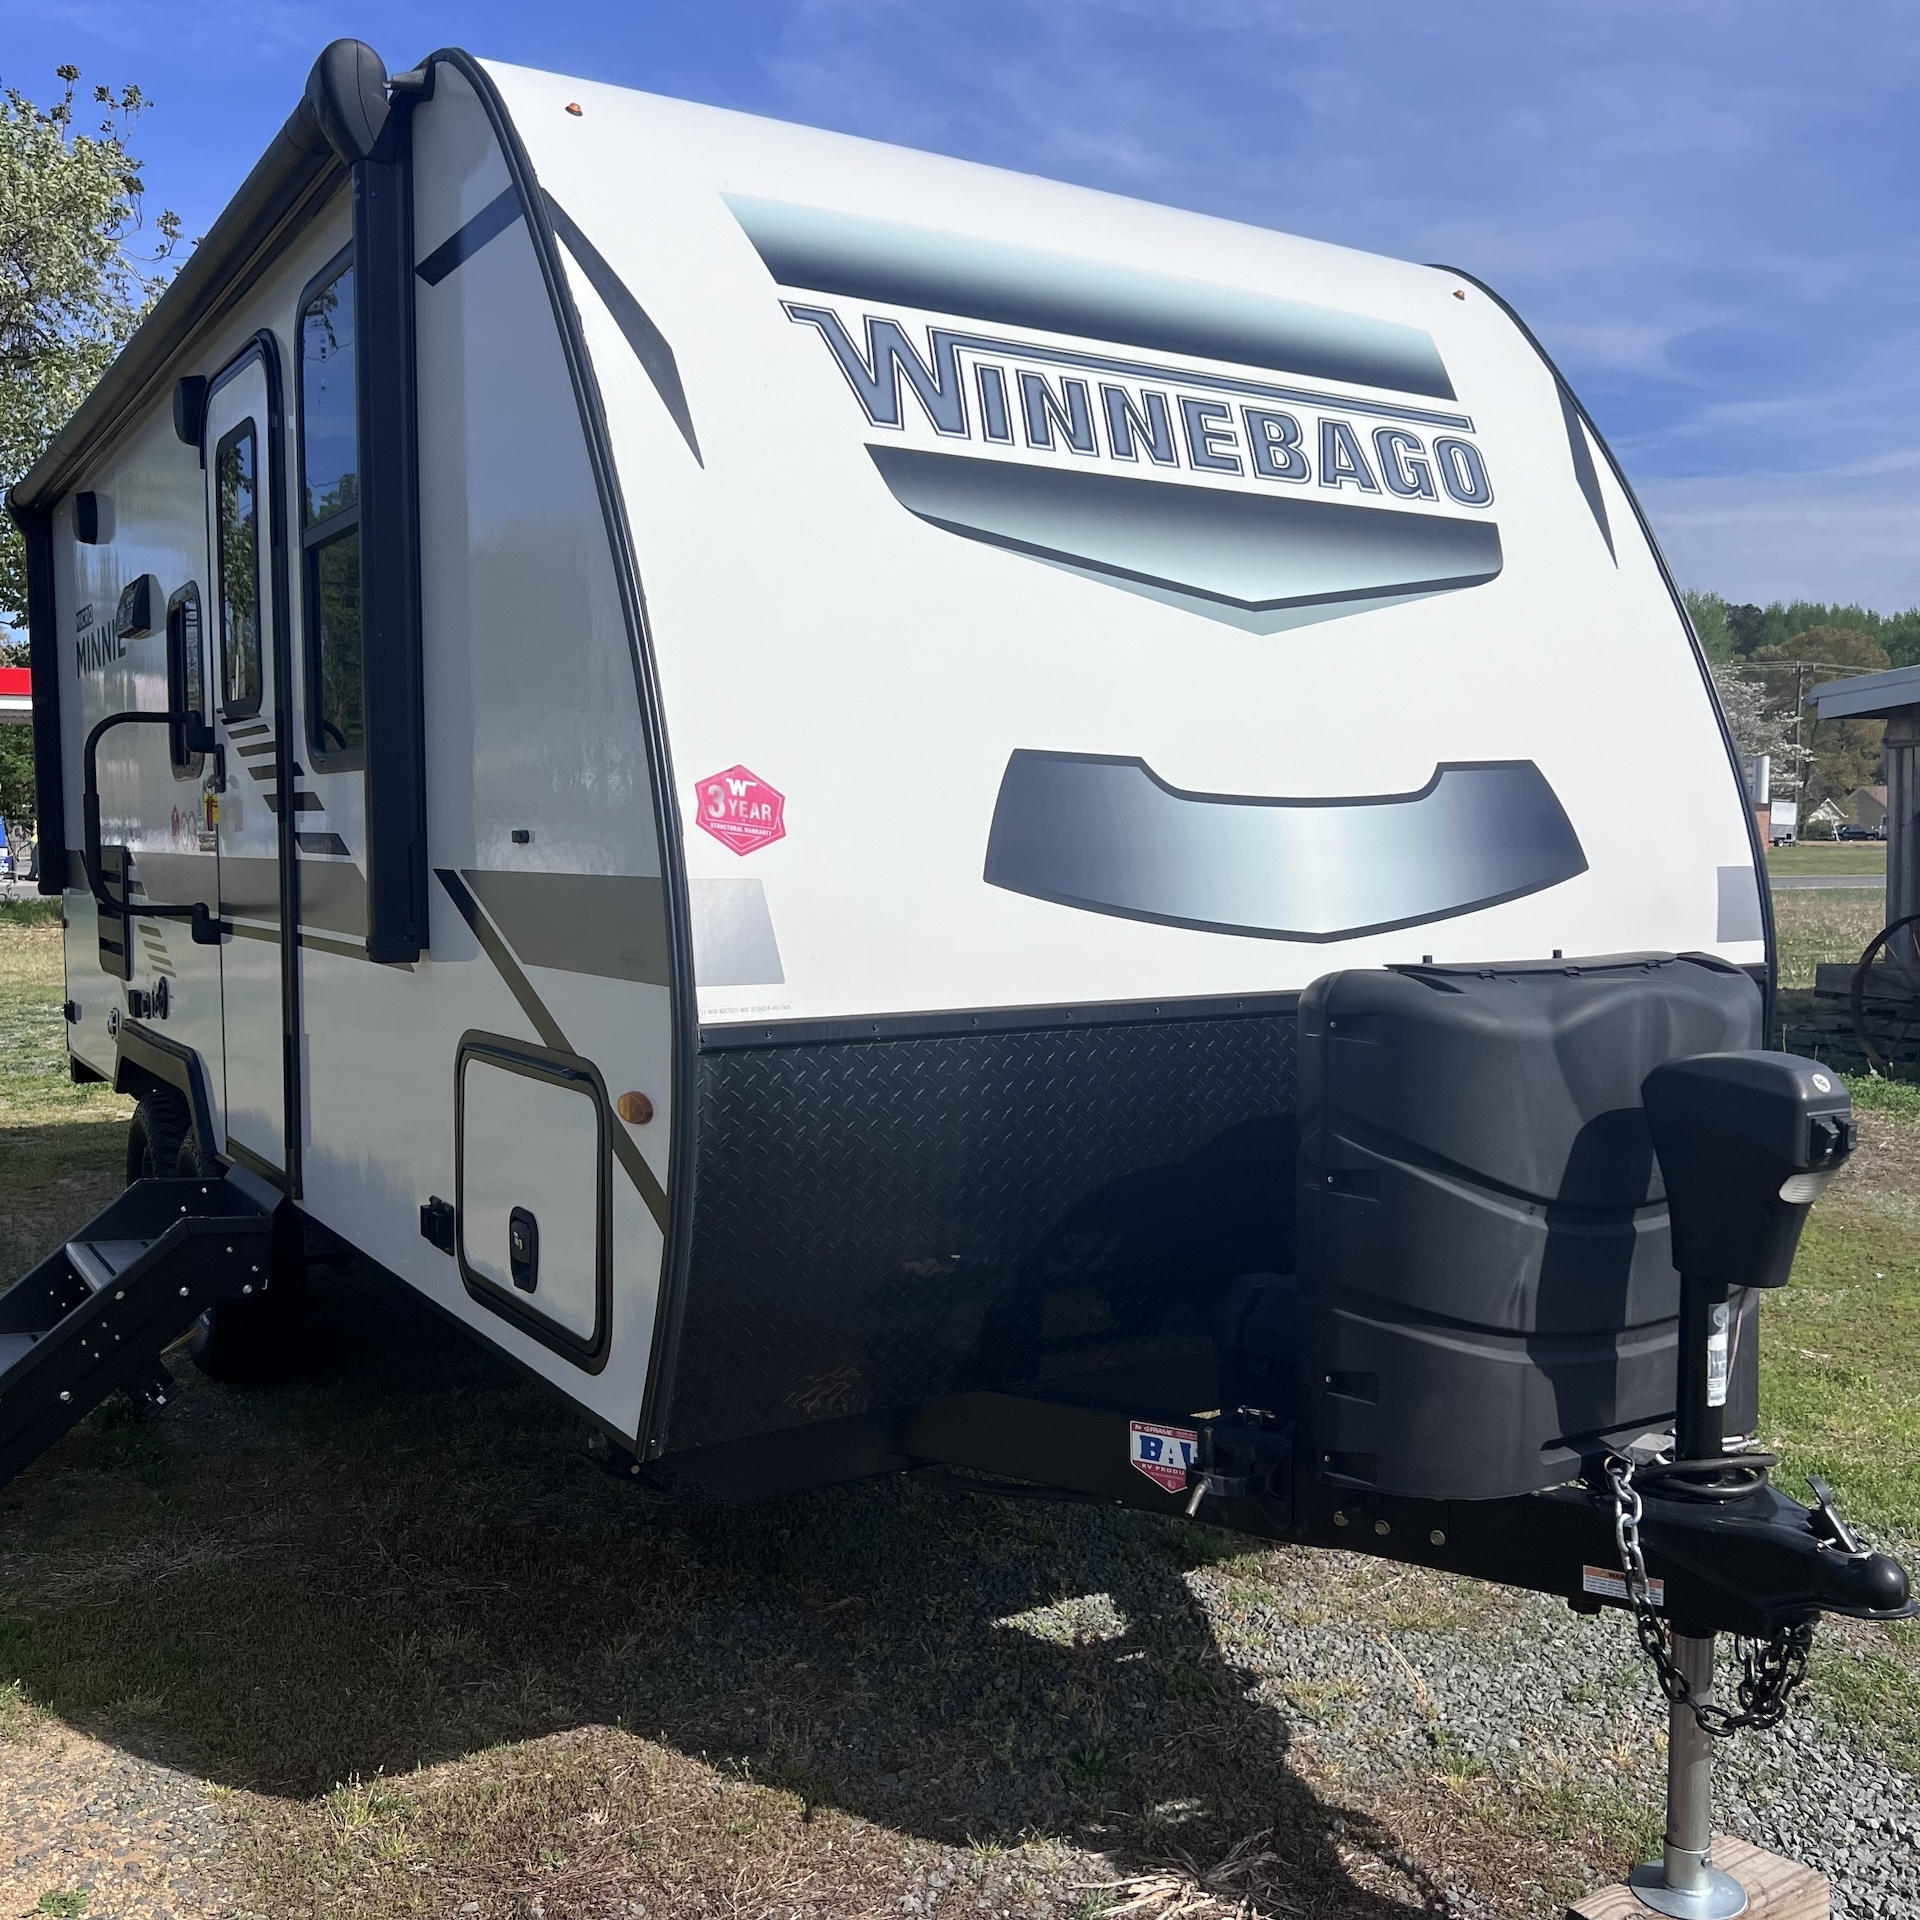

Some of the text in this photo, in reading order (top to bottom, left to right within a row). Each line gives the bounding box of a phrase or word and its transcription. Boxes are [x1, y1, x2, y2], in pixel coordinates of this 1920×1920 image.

[778, 299, 1494, 508] WINNEBAGO
[707, 784, 772, 821] 3 YEAR
[710, 822, 772, 837] STRUCTURAL WARRANTY
